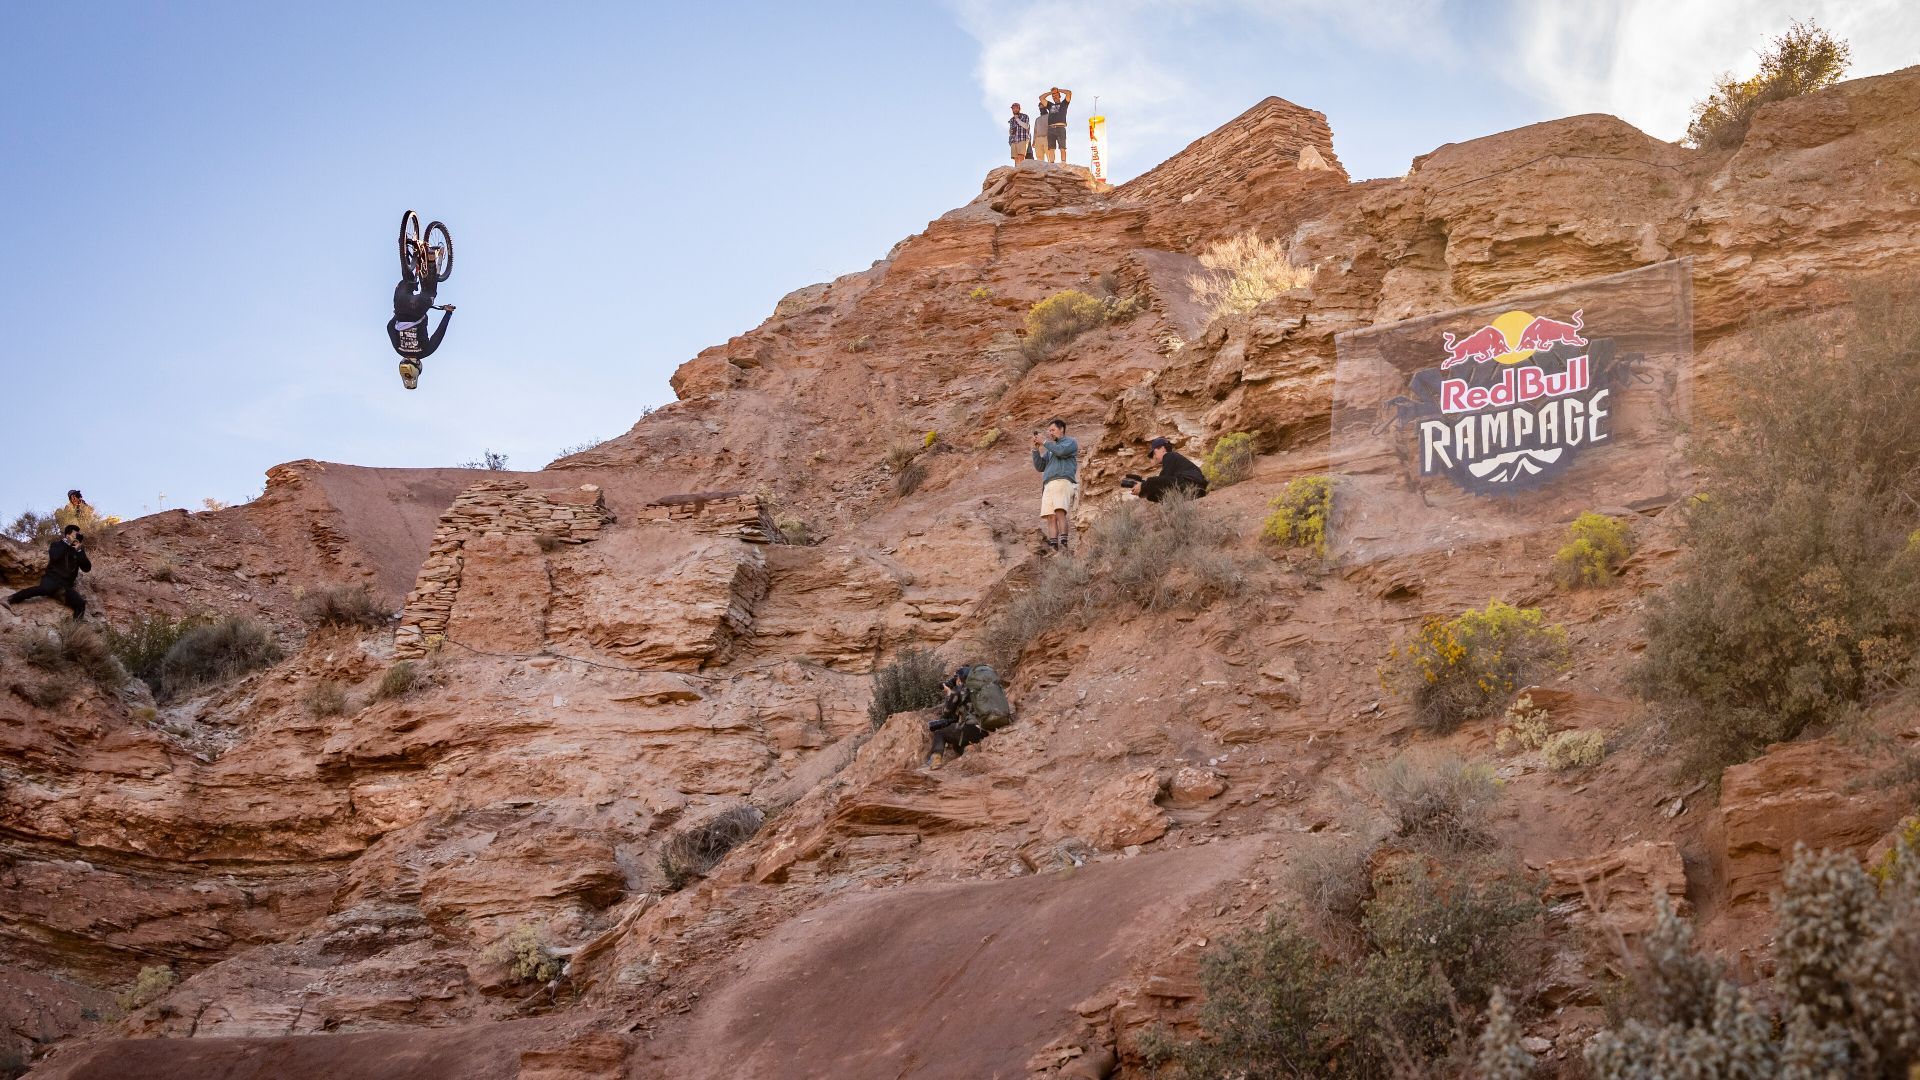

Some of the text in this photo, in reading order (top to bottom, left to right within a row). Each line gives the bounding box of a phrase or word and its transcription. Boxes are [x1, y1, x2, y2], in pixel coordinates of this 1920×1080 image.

[1091, 145, 1101, 178] Red Bull
[1442, 356, 1588, 413] Red Bull
[1420, 389, 1609, 472] RAMPAGE
